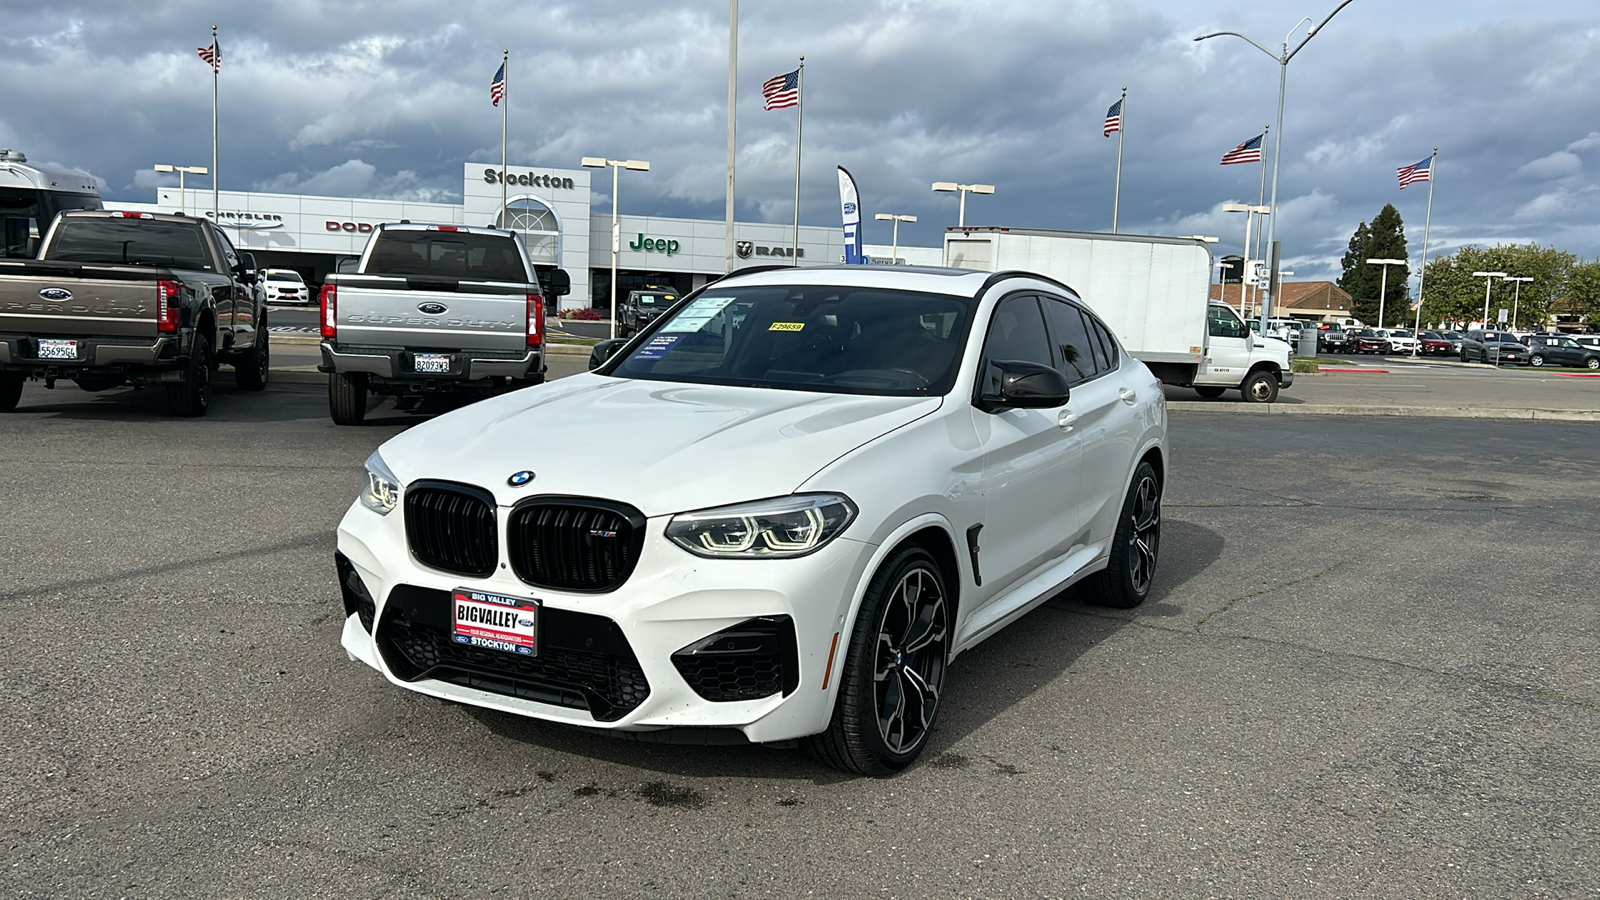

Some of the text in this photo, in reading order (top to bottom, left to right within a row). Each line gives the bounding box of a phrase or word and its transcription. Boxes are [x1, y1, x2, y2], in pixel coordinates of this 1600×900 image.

[484, 168, 574, 189] Stockton
[205, 211, 282, 221] CHRYSLER
[325, 221, 376, 233] DOD
[629, 233, 680, 255] Jeep
[755, 246, 804, 257] RAM
[72, 304, 146, 315] DUTY
[348, 314, 516, 329] SUPER DUTY
[472, 593, 516, 606] BIG VALLEY
[457, 604, 519, 629] BIGVALLEY
[470, 637, 516, 652] STOCKTON
